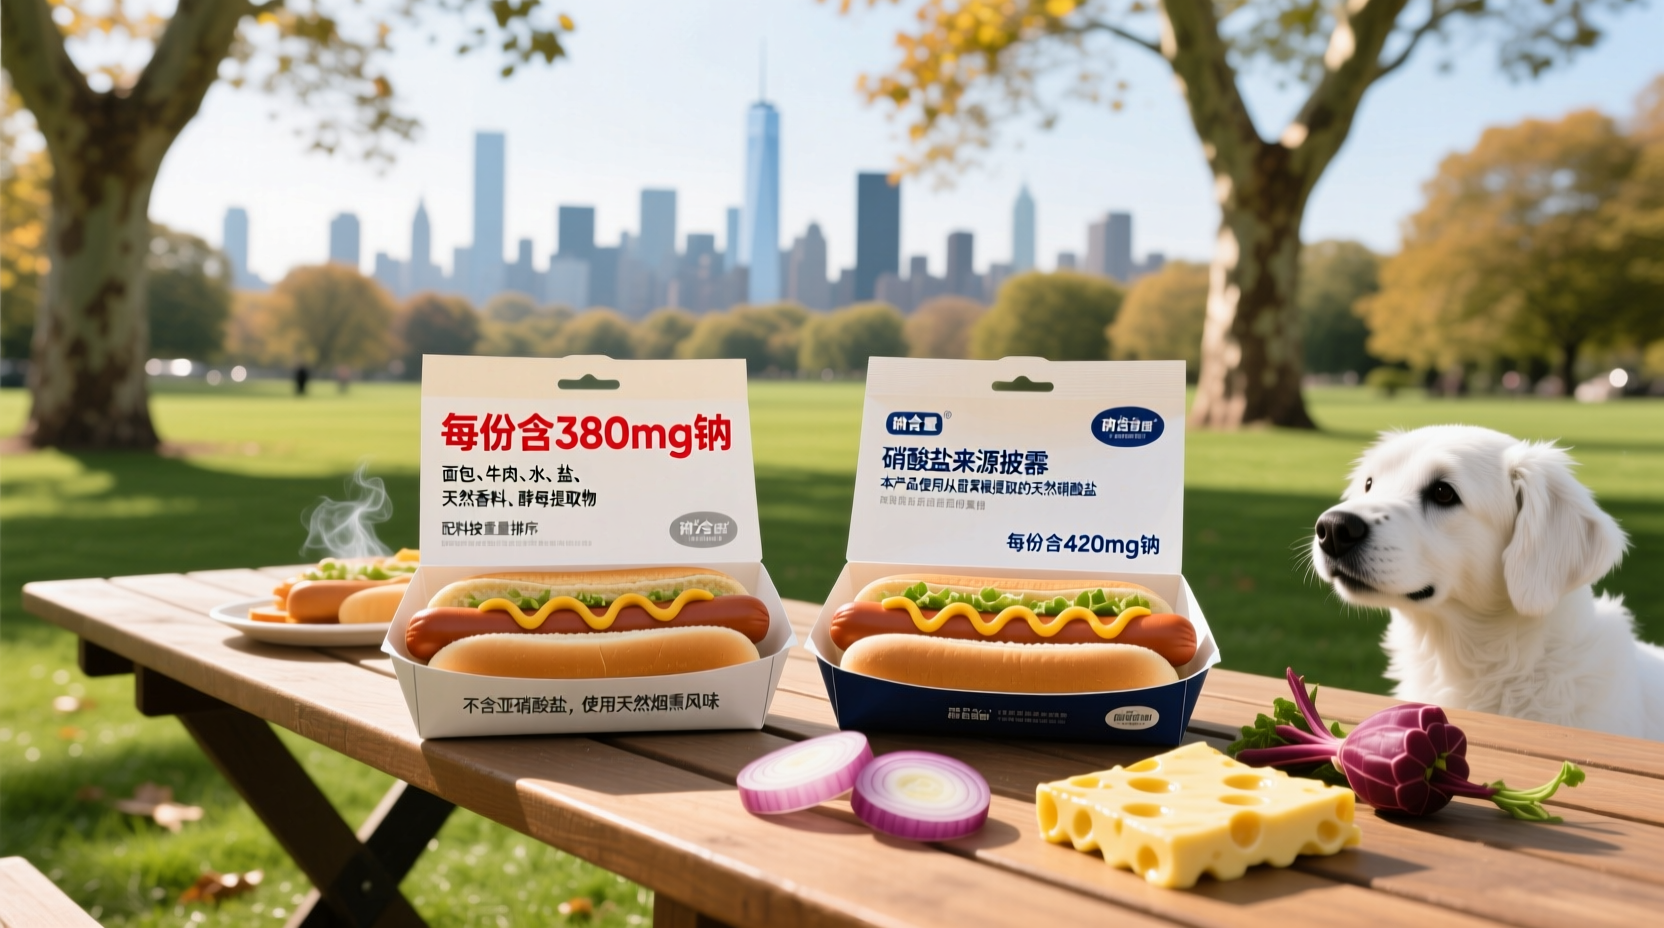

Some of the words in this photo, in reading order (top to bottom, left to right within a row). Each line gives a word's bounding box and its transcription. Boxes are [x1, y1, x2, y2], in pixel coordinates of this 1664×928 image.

[440, 412, 732, 459] 每份含380mg钠
[442, 464, 581, 484] 面包、牛肉、水、盐、
[1006, 532, 1160, 559] 每份含420mg钠
